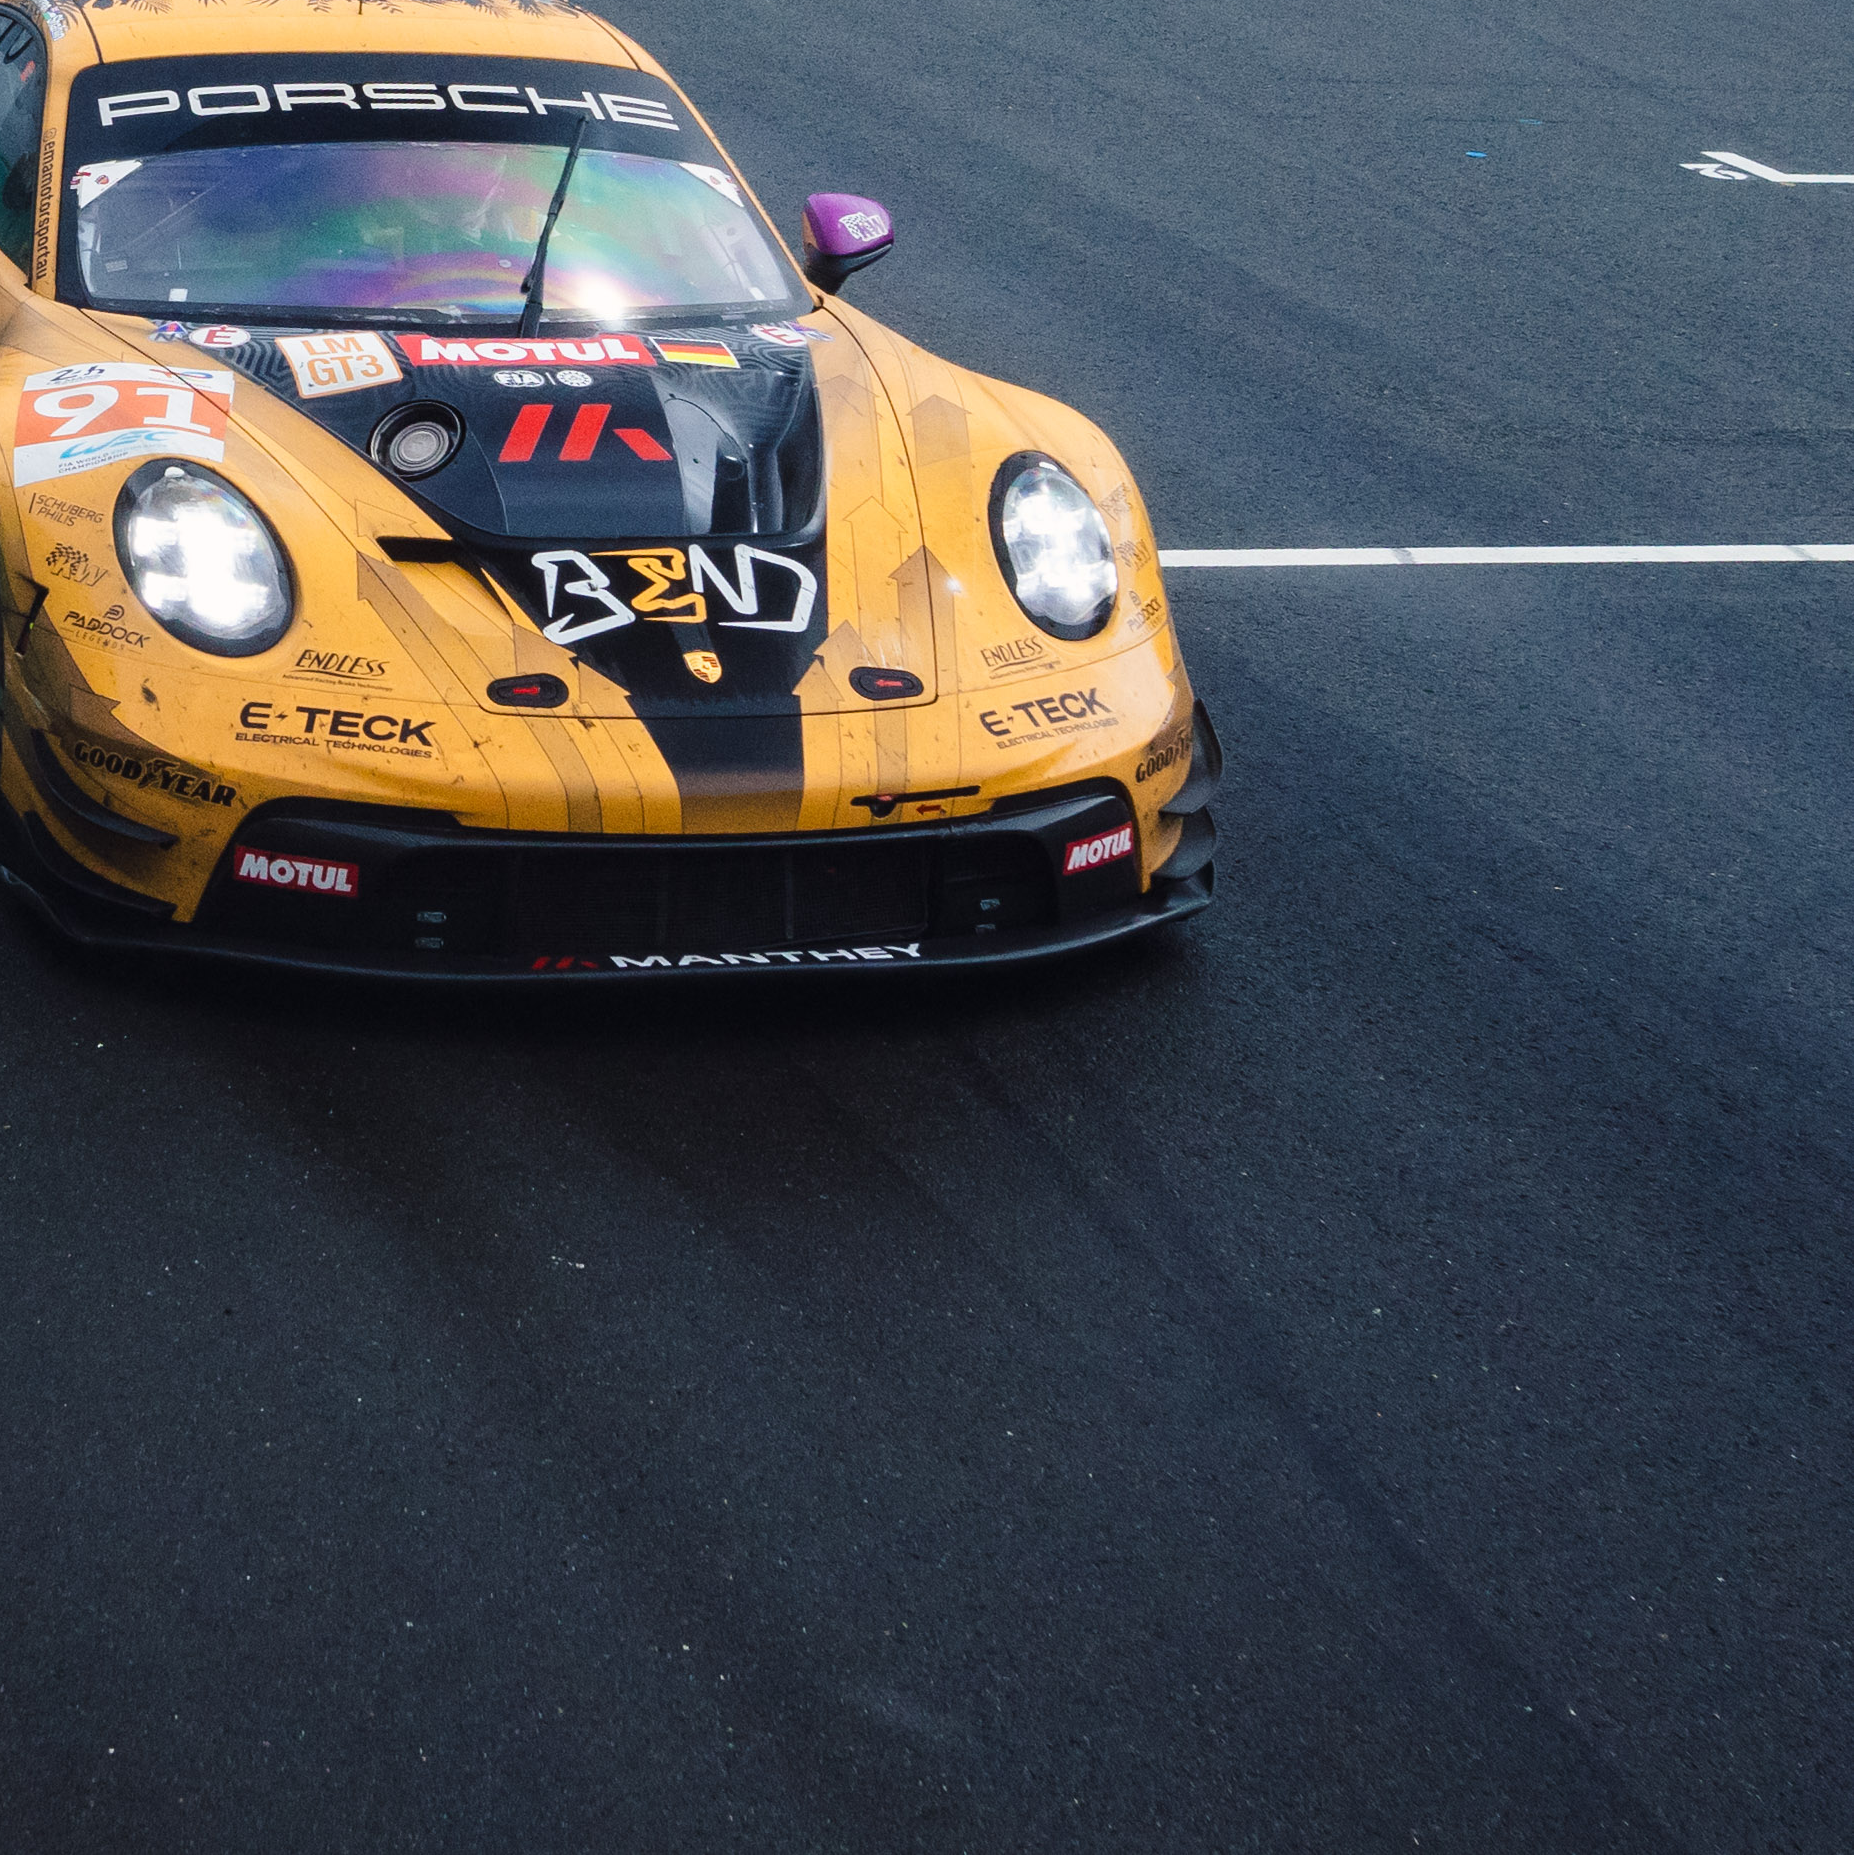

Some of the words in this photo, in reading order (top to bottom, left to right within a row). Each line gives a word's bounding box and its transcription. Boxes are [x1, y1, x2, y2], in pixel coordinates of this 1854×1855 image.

[97, 83, 680, 131] PORSCHE
[36, 127, 57, 279] @emamotorsportau
[303, 334, 364, 357] LM
[420, 338, 640, 361] MOTUL
[307, 355, 384, 386] GT3
[497, 372, 542, 386] FIA
[33, 385, 211, 437] 91
[58, 451, 129, 473] CHAMPIONSHIP
[77, 453, 109, 466] WORLD
[36, 494, 104, 524] SCHUBERG
[63, 611, 152, 648] PADDOCK
[295, 649, 391, 677] ENDLESS
[981, 636, 1044, 667] ENDLESS
[235, 732, 320, 747] ELECTRICAL
[324, 739, 433, 759] TECHNOLOGIES
[996, 730, 1054, 749] ELECTRICAL
[1054, 717, 1120, 738] TECHNOLOGIES
[1067, 826, 1132, 871] MOTUL
[238, 853, 353, 893] MOTUL
[609, 944, 924, 970] MANTHEY
